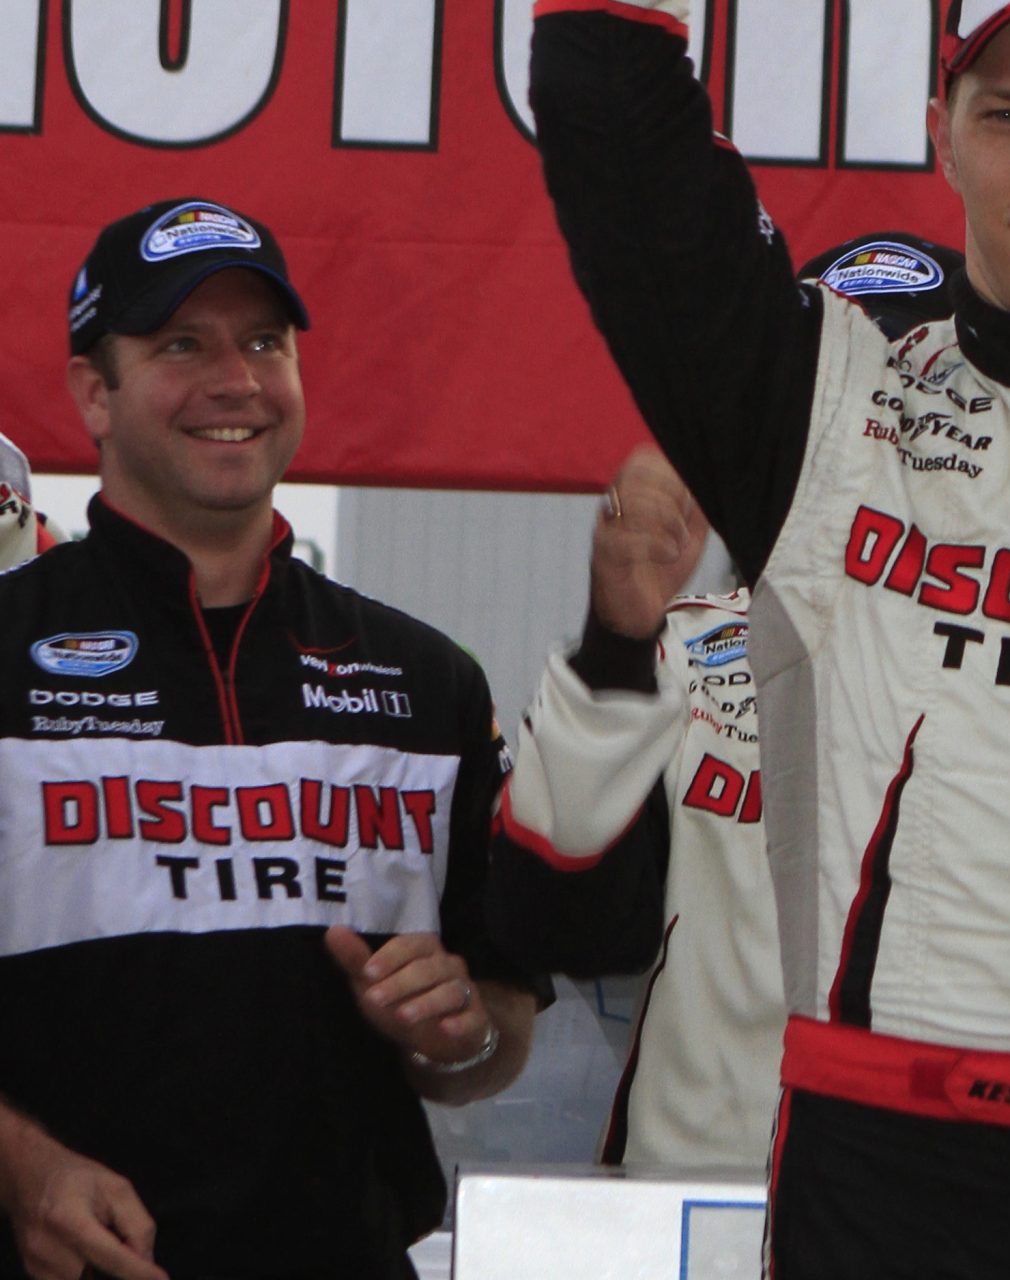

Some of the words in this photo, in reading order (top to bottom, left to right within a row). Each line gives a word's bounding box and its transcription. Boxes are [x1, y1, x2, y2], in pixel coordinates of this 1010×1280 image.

[838, 267, 919, 284] Nationwide
[863, 418, 900, 447] Rub
[897, 447, 983, 479] Tuesday
[29, 688, 160, 708] DODGE
[302, 682, 380, 714] Mobil
[41, 774, 436, 854] DISCOUNT
[156, 854, 348, 903] TIRE
